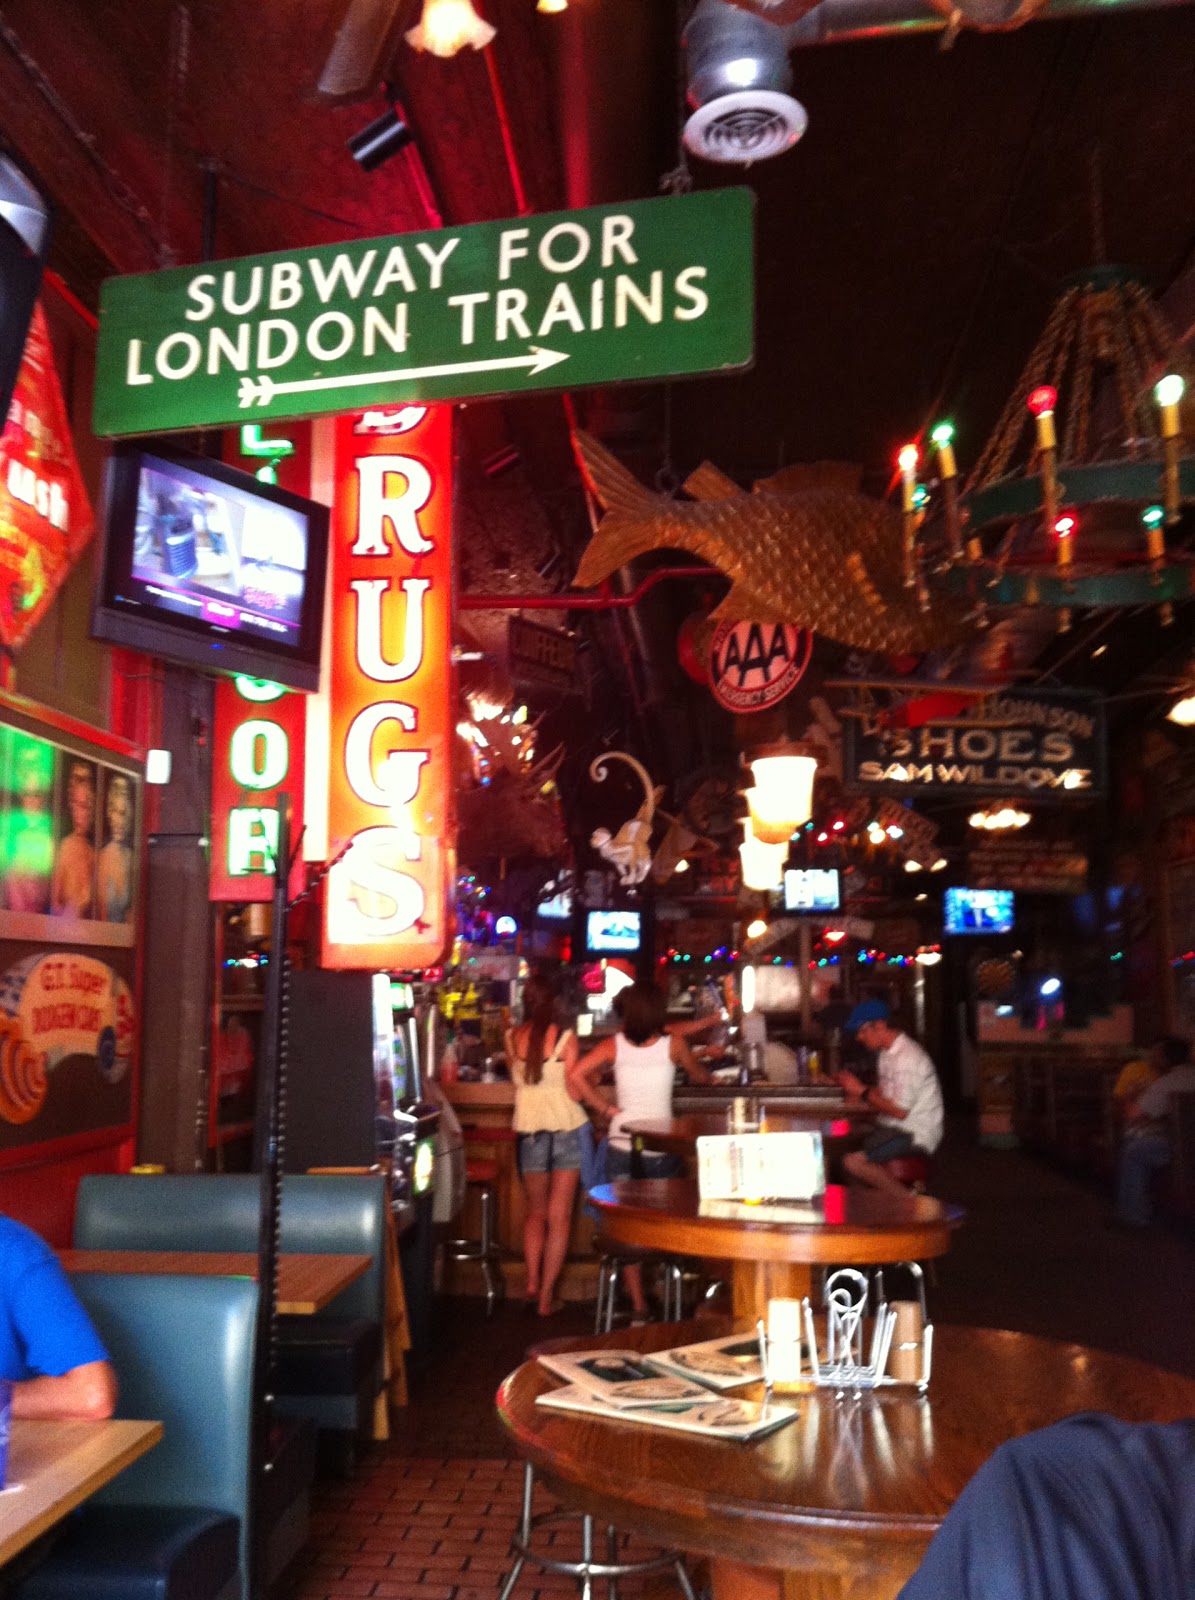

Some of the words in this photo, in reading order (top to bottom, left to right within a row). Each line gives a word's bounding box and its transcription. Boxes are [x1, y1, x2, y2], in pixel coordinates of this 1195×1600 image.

[185, 238, 460, 321] SUBWAY
[499, 215, 639, 281] FOR
[125, 302, 410, 386] LONDON
[448, 266, 710, 344] TRAINS
[723, 623, 790, 687] AAA
